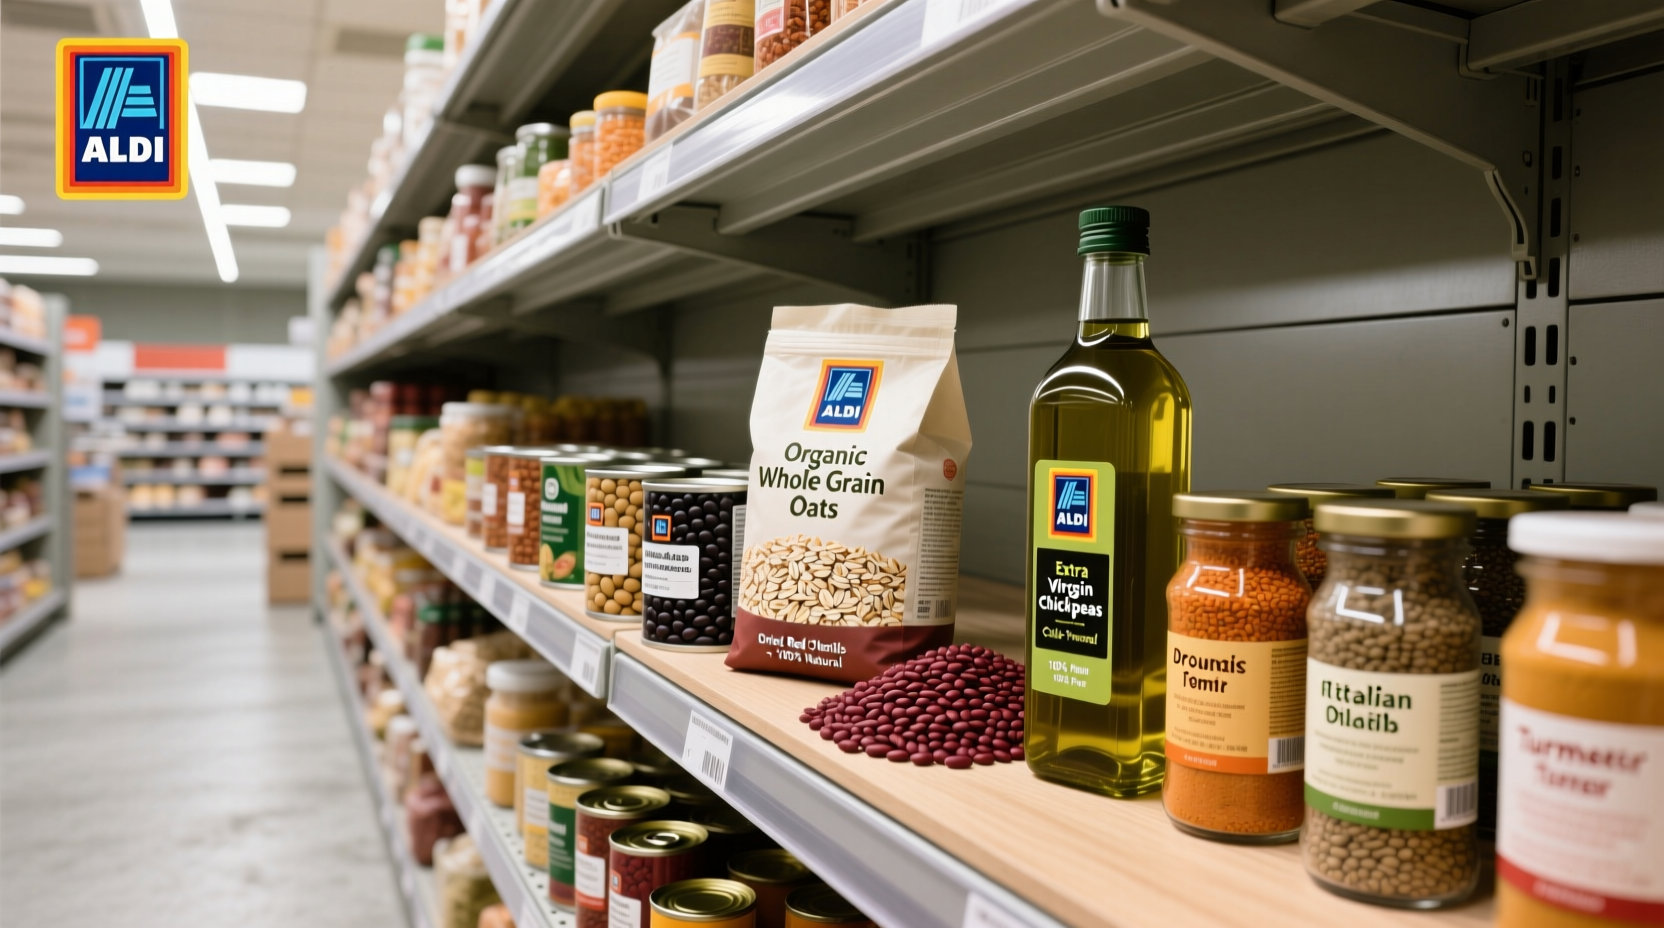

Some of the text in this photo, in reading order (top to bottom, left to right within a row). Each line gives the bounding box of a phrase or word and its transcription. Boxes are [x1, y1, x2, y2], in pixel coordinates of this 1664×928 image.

[821, 404, 861, 418] ALDI
[784, 442, 868, 470] Organic
[759, 466, 885, 495] Whole Grain
[790, 495, 838, 519] Oats
[1056, 512, 1088, 527] ALDI
[1055, 561, 1089, 579] Extra
[1048, 577, 1093, 599] Virgin
[1038, 595, 1103, 619] Chickpeas
